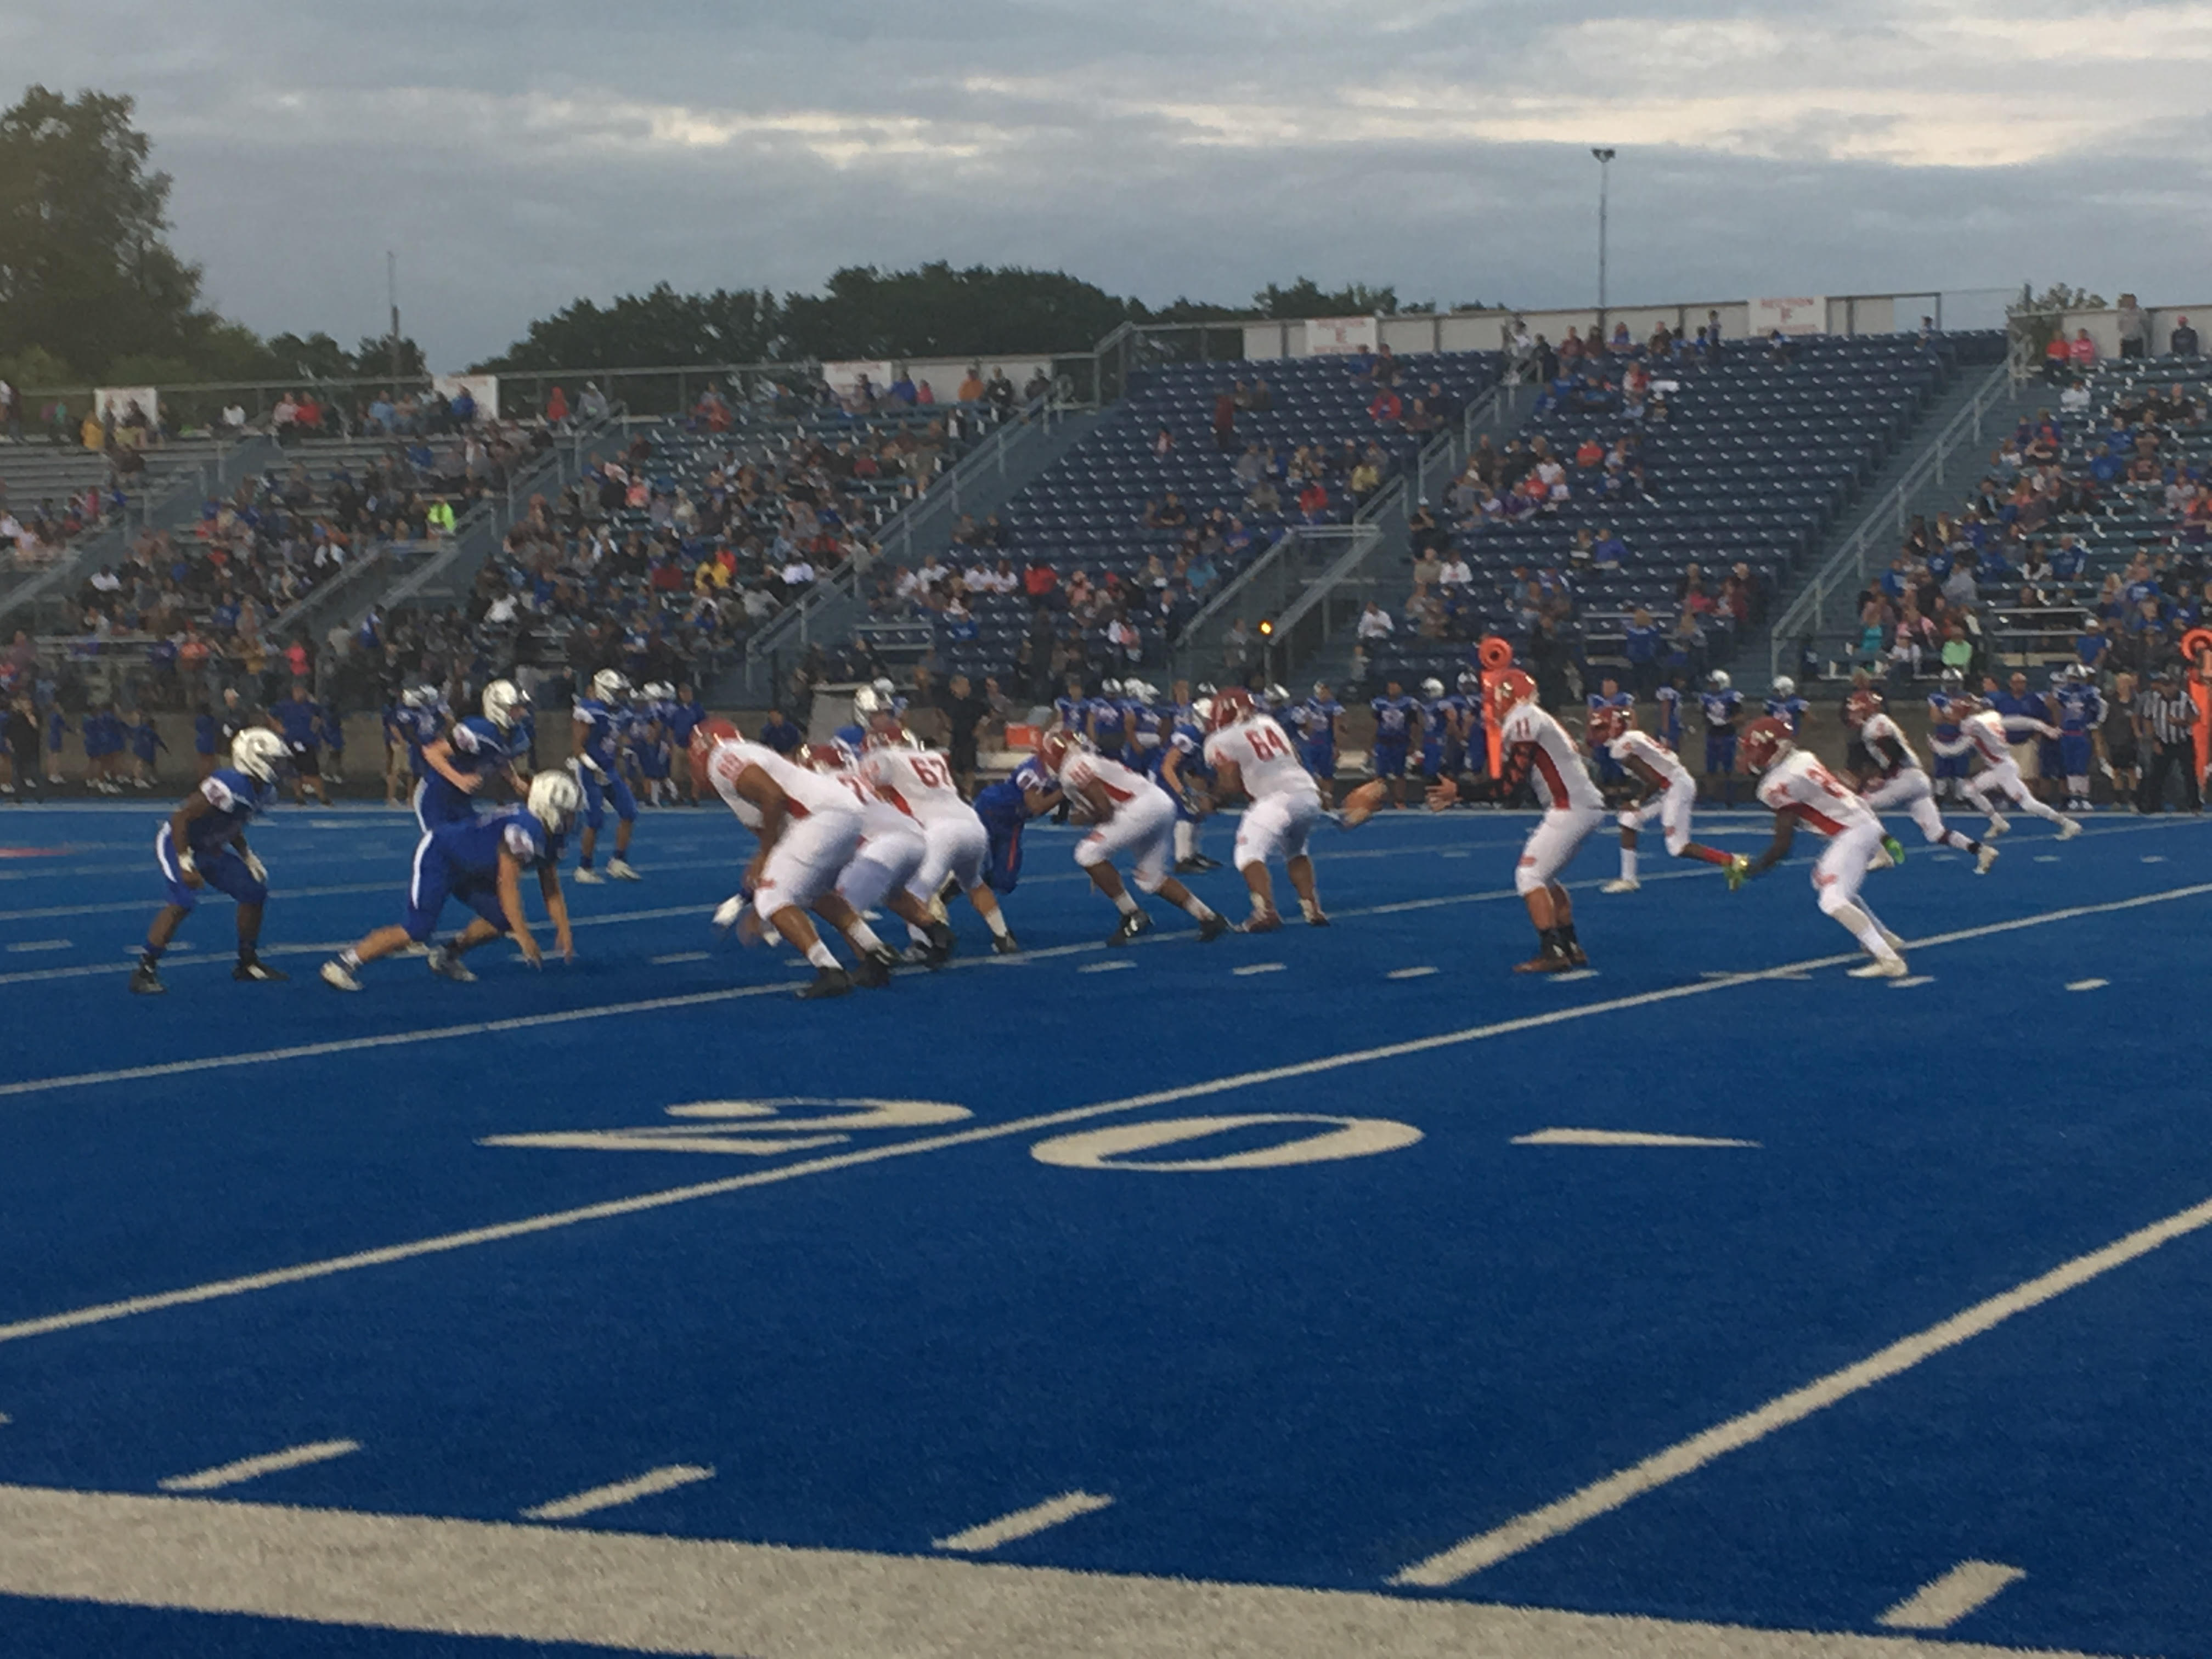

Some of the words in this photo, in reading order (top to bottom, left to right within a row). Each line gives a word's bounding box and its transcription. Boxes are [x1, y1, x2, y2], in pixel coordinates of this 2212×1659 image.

[1516, 717, 1530, 736] 11
[908, 756, 953, 789] 67
[478, 1099, 1424, 1173] 20
